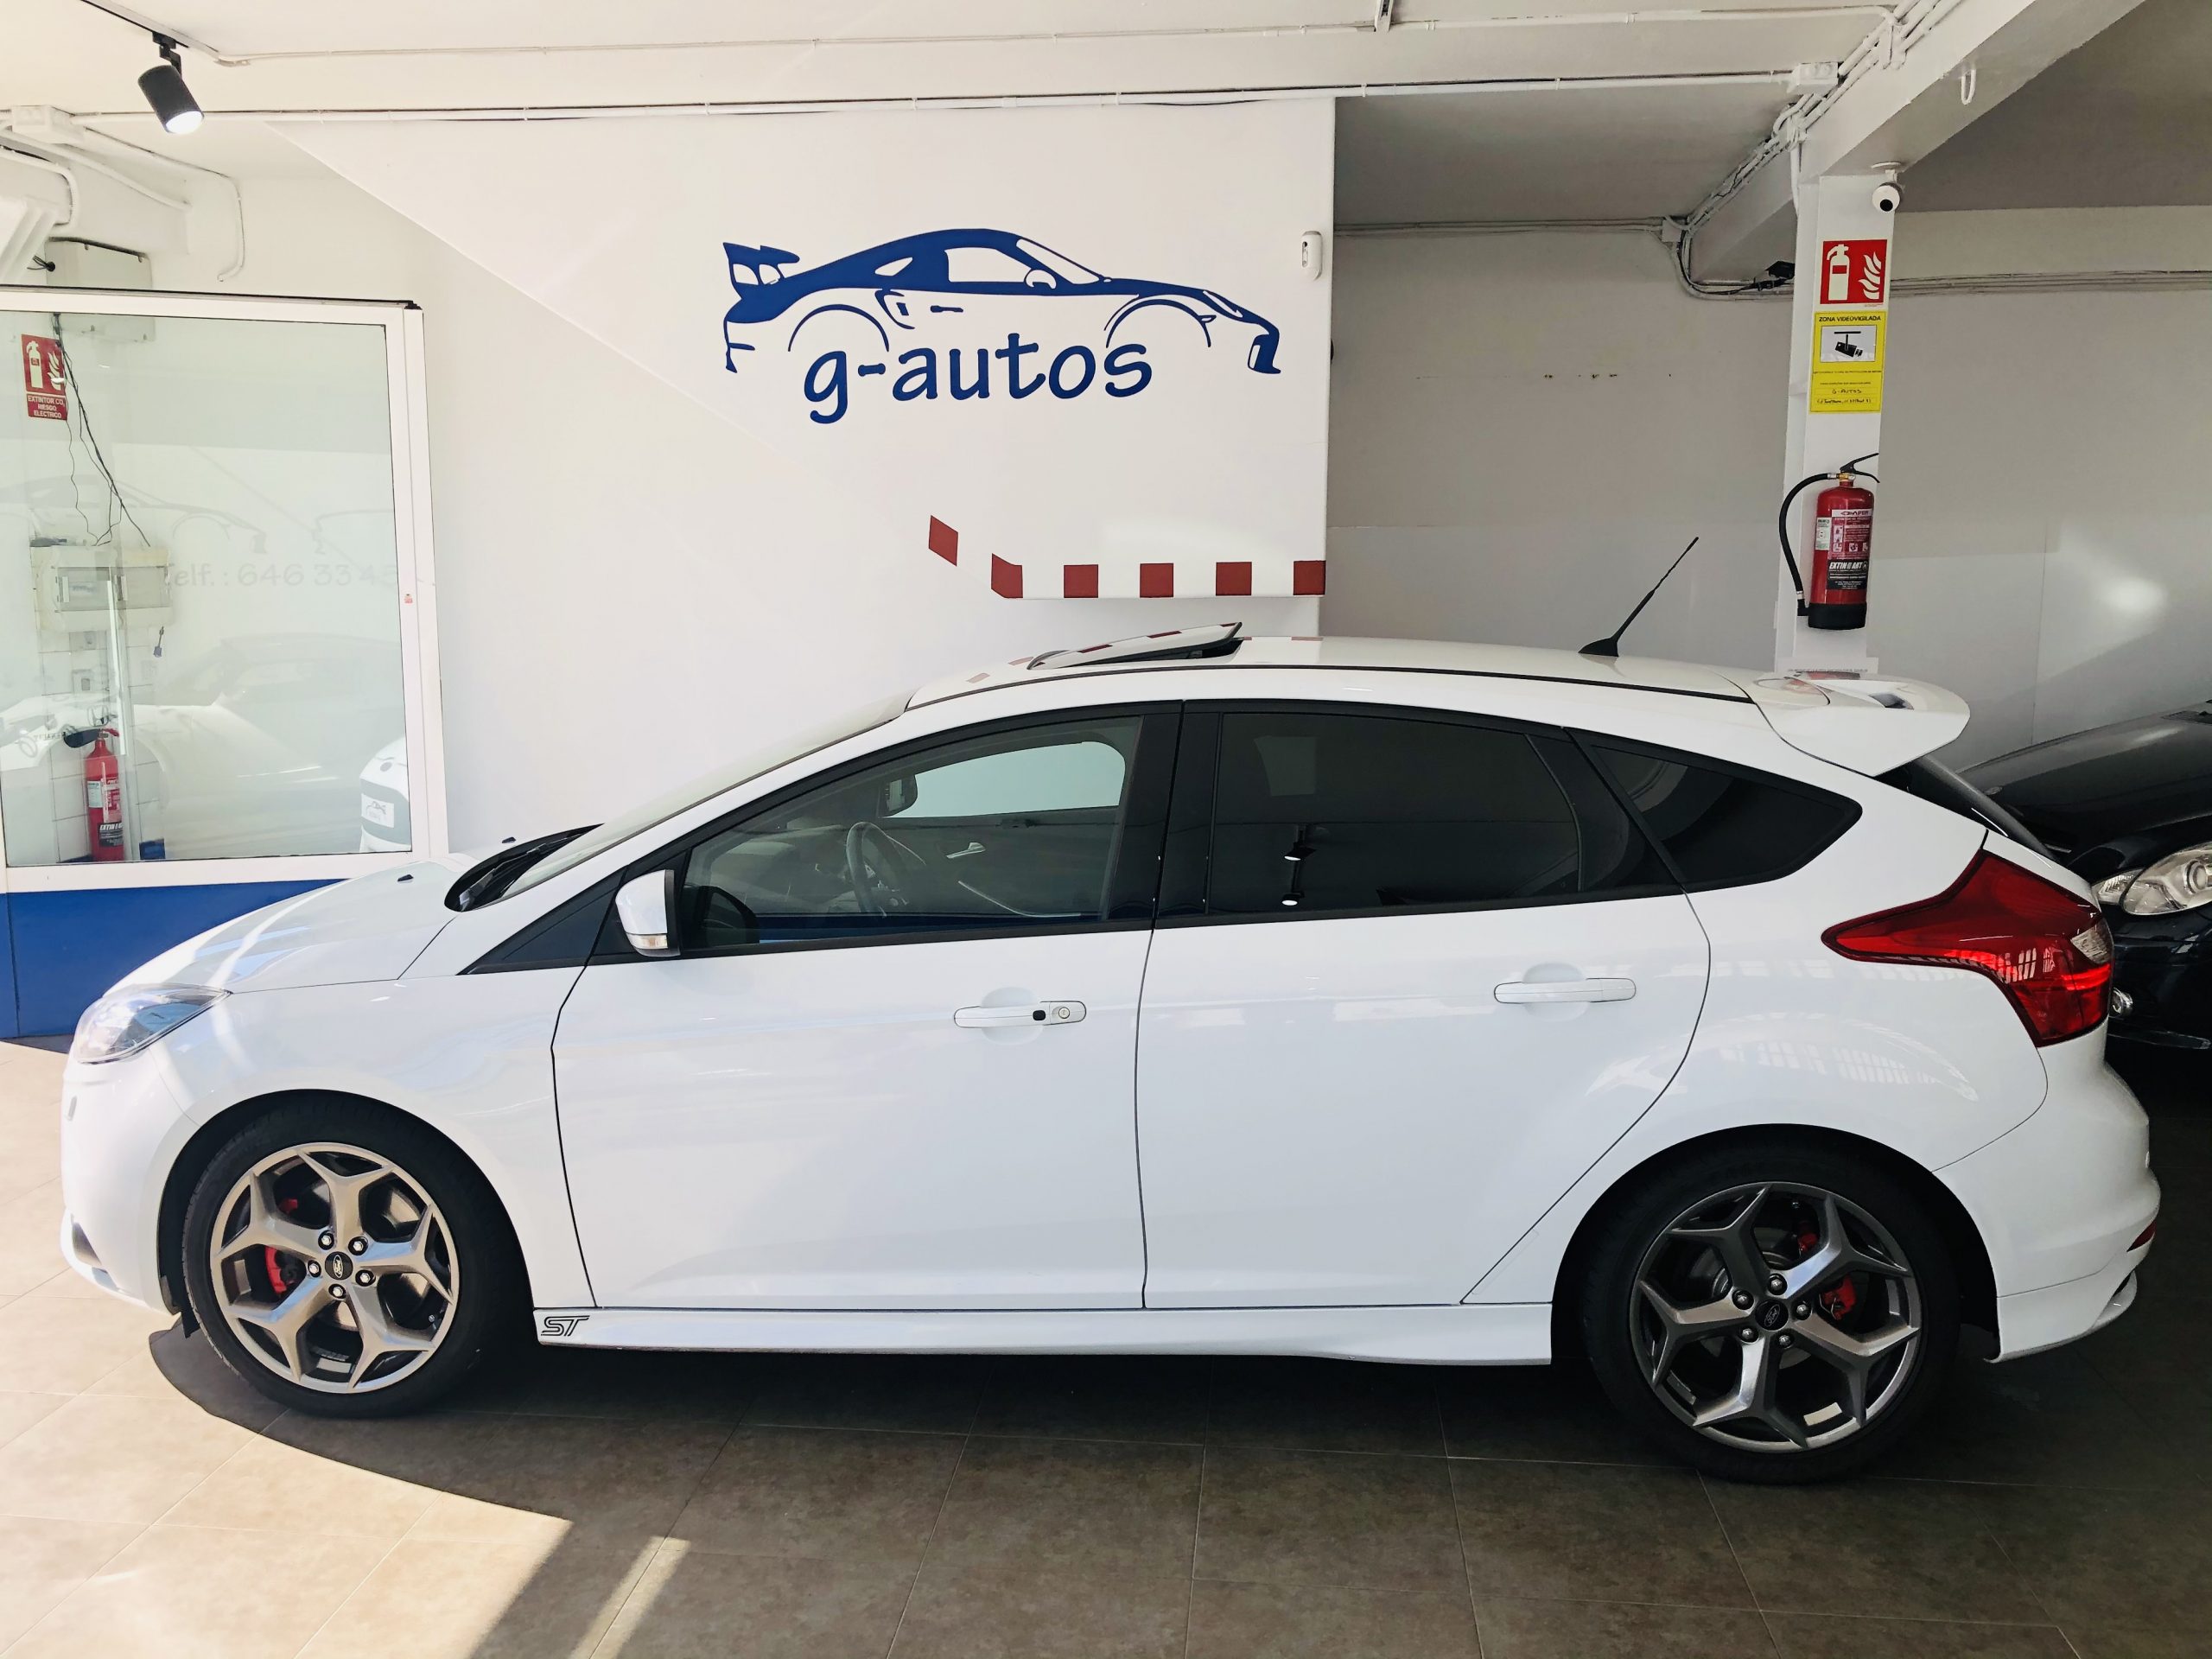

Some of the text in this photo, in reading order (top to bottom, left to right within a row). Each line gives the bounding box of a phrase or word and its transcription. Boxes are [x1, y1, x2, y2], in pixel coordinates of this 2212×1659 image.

[804, 333, 1153, 424] g-autos
[28, 395, 54, 404] EXTINTOR
[238, 563, 305, 587] 646
[314, 563, 352, 587] 33
[541, 1315, 590, 1337] ST
